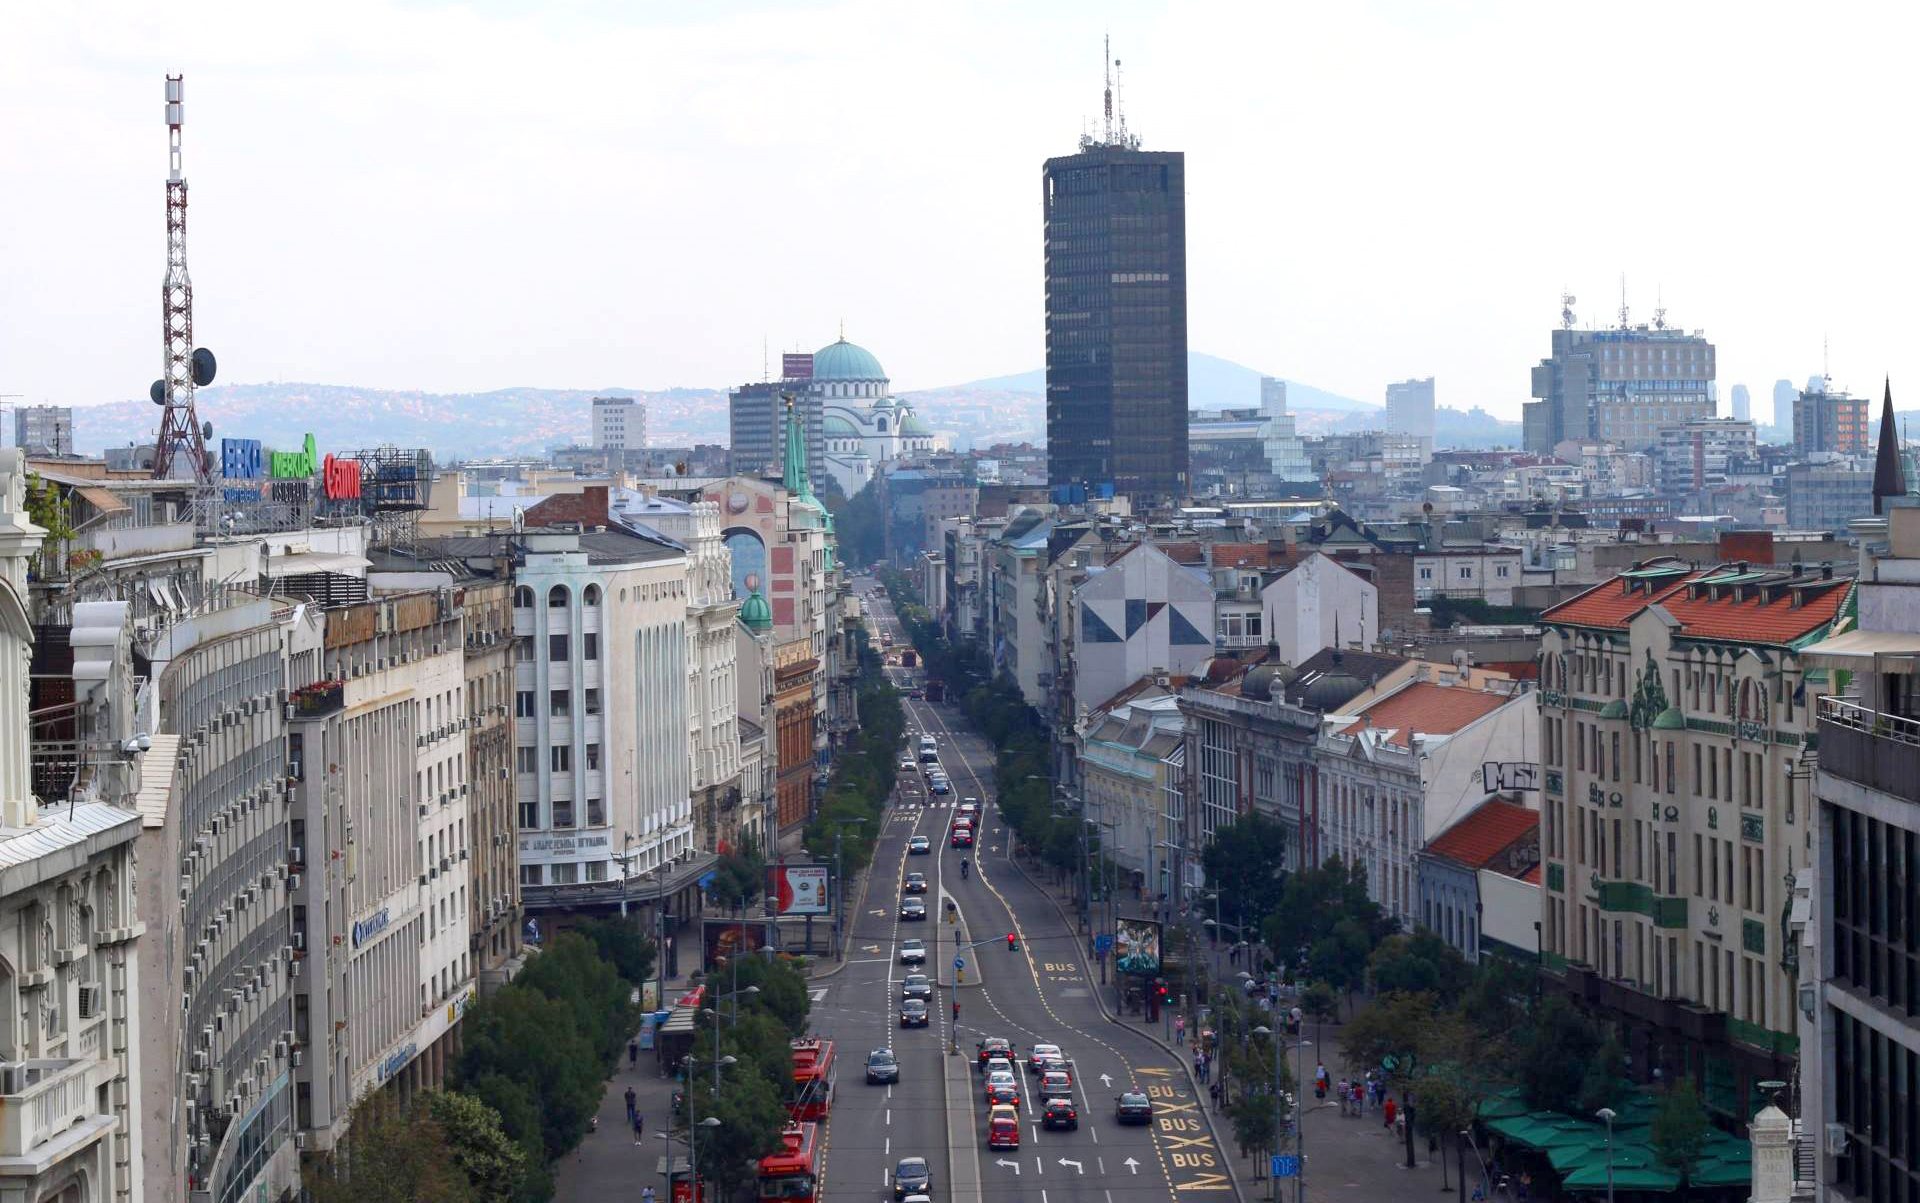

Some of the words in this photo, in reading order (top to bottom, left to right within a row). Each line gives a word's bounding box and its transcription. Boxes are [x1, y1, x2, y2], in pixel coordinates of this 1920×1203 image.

[271, 452, 310, 478] MERKUR
[323, 453, 362, 500] Canon
[1044, 963, 1077, 971] BUS
[1159, 1118, 1201, 1131] BUS
[1171, 1153, 1216, 1167] BUS
